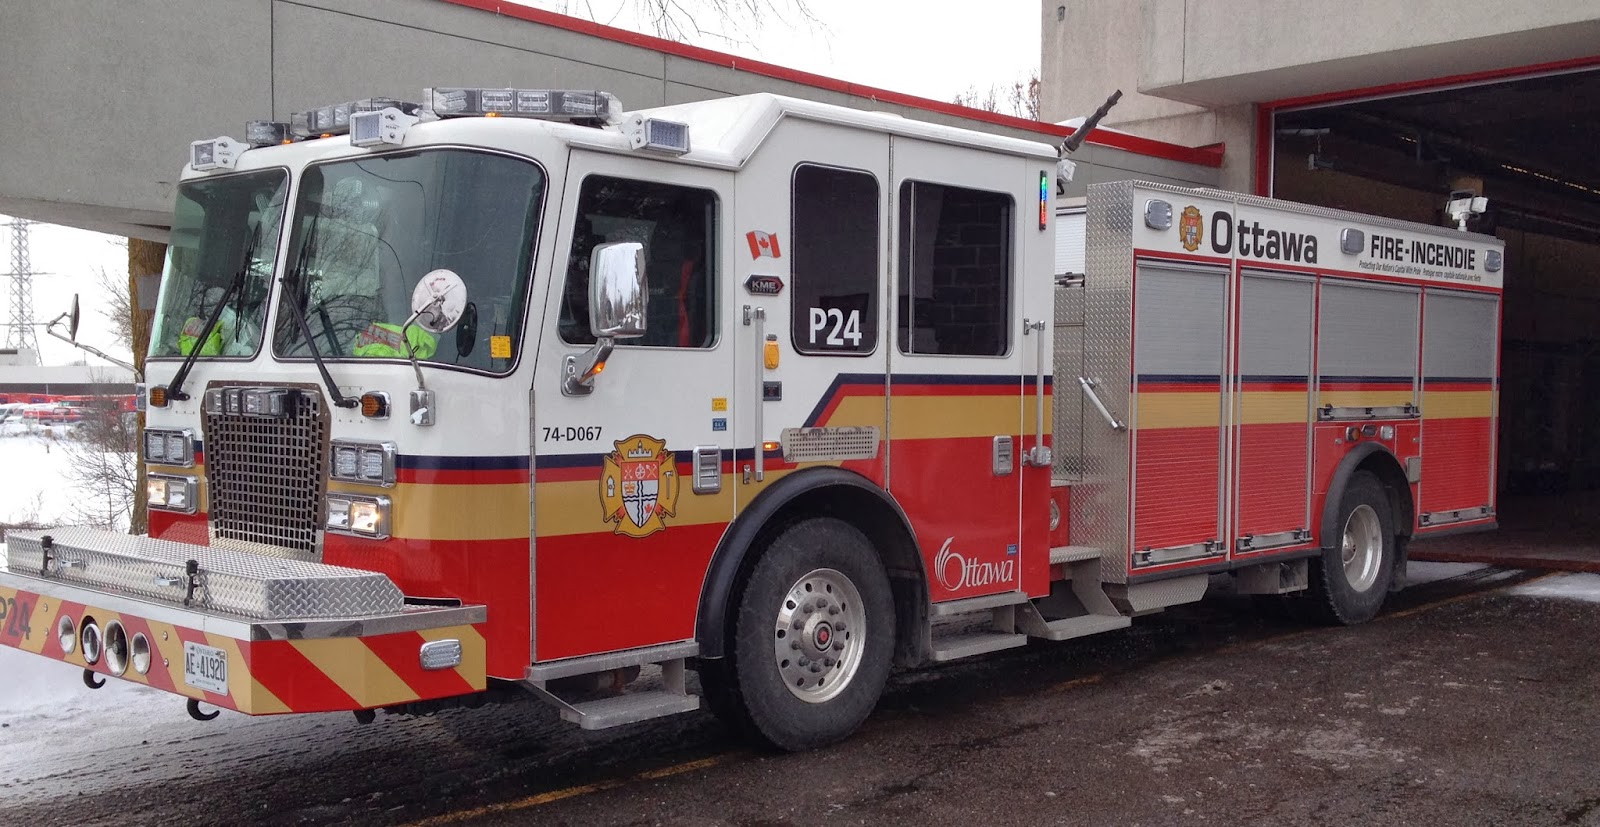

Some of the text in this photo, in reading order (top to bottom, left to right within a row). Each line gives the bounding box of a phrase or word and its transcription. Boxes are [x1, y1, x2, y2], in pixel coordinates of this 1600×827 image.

[1211, 210, 1318, 264] Ottawa
[1370, 234, 1476, 270] FIRE-INCENDIE
[752, 280, 776, 289] KME
[809, 307, 863, 346] P24
[542, 426, 602, 442] 74-D067
[934, 536, 1014, 591] Ottawa
